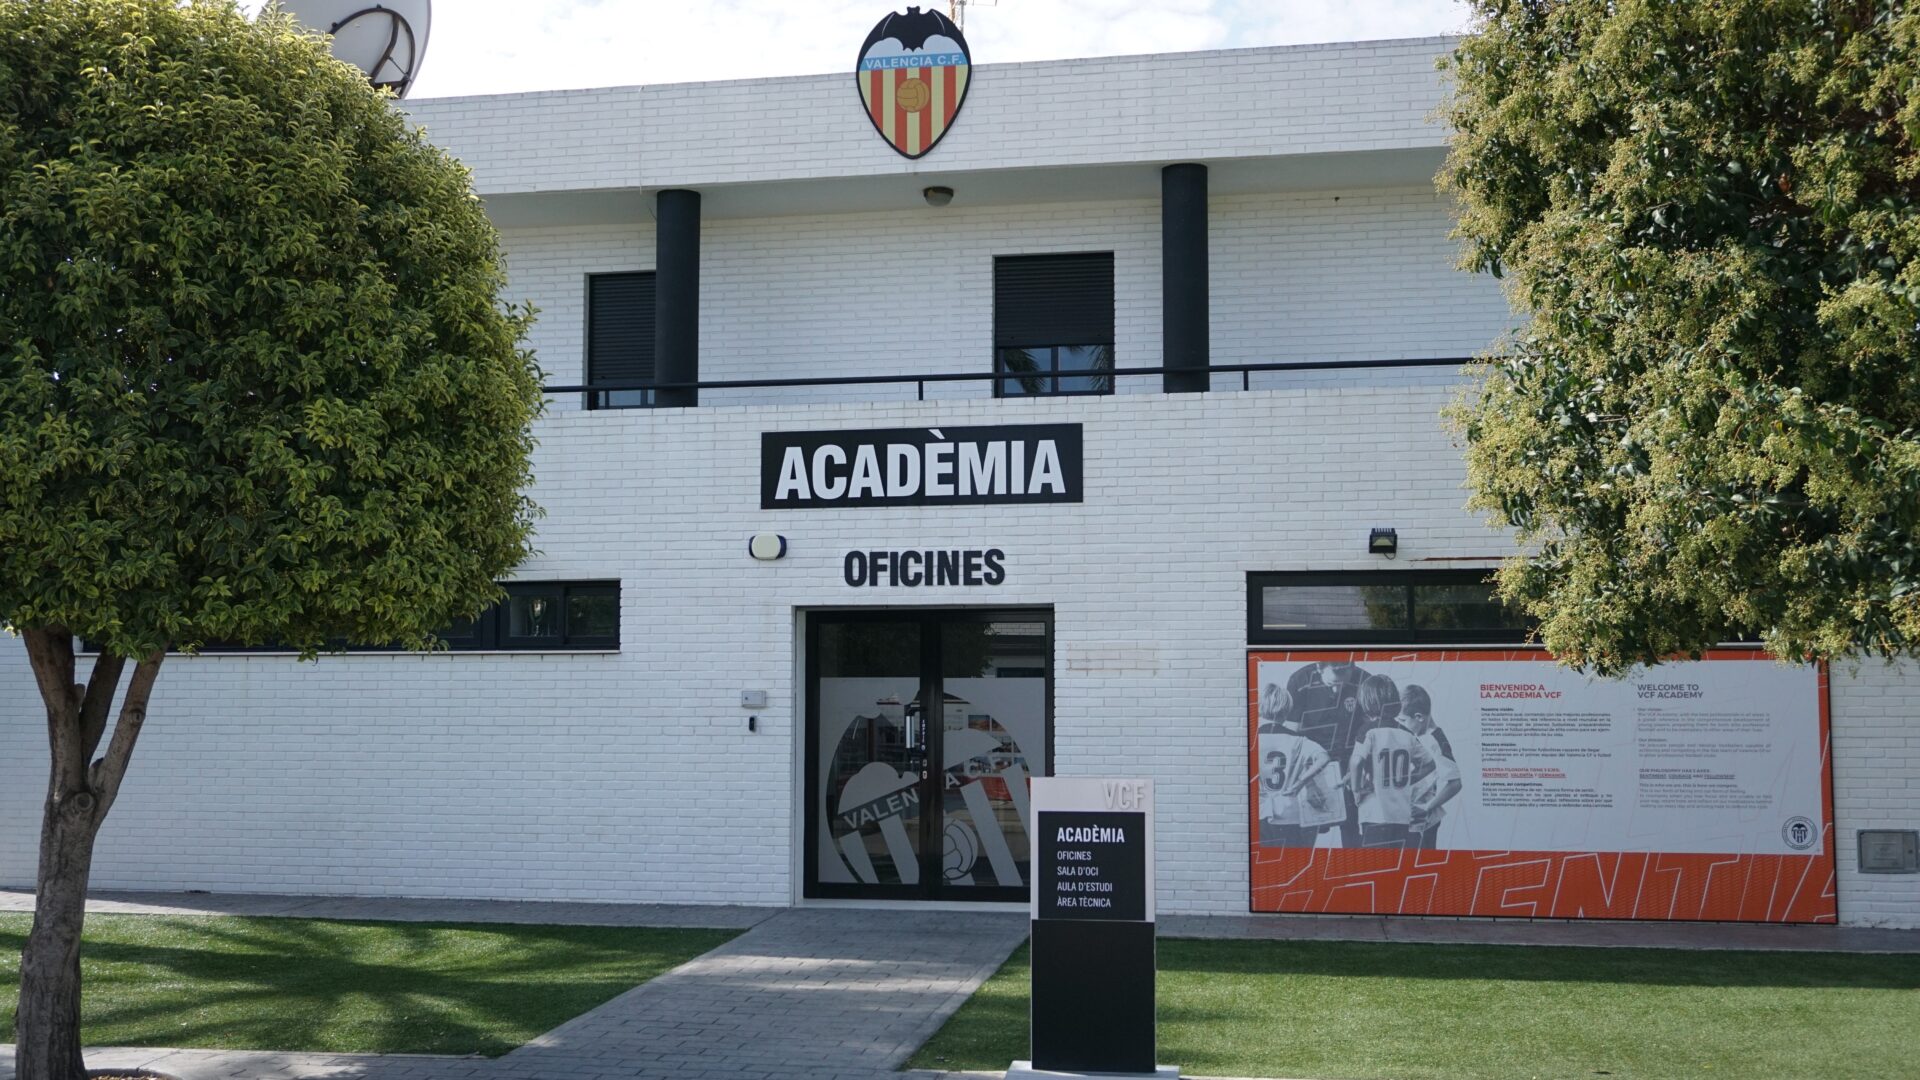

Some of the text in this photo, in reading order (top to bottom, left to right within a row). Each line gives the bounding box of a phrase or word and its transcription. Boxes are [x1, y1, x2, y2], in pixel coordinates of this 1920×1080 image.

[865, 54, 962, 69] VALENCIA C.F.
[774, 428, 1066, 501] ACADÈMIA
[844, 548, 1006, 588] OFICINES
[1480, 684, 1536, 692] BIENVENIDO
[1687, 683, 1699, 691] TO
[1480, 691, 1562, 699] LA ACADEMIA VCF
[1637, 691, 1703, 699] VCF ACADEMY
[1378, 747, 1411, 790] 10
[1102, 782, 1146, 810] VCF
[1057, 824, 1125, 843] ACADÈMIA
[1057, 851, 1092, 861] OFICINES
[1057, 866, 1099, 876] SALA D'OCI
[1057, 882, 1113, 892] AULA D'ESTUDI
[1079, 896, 1111, 907] TÈCNICA
